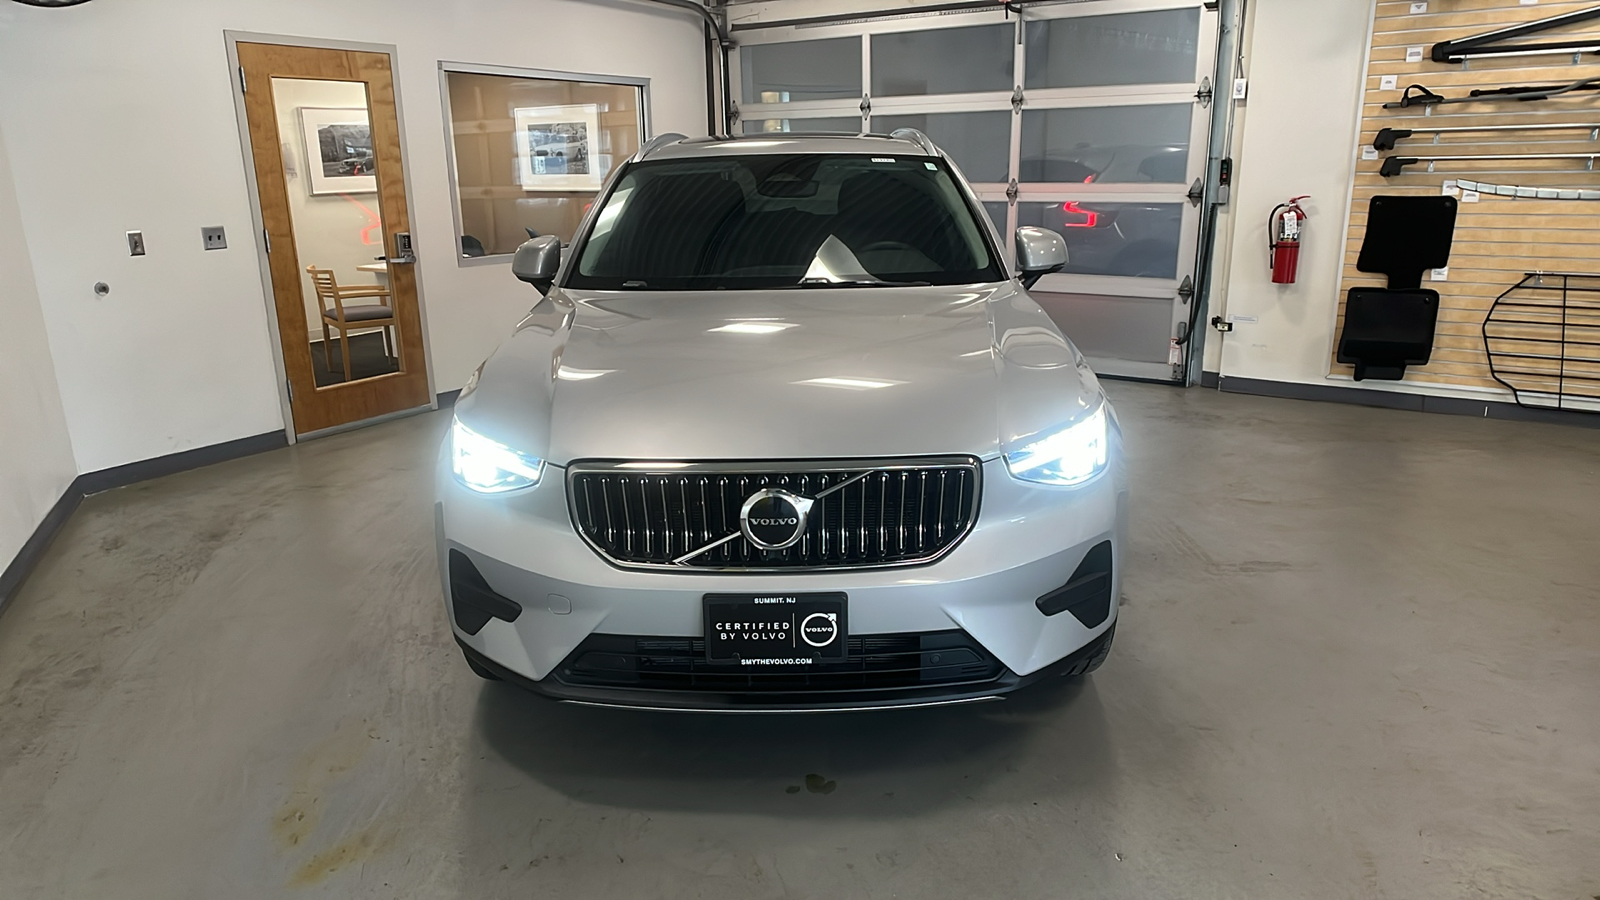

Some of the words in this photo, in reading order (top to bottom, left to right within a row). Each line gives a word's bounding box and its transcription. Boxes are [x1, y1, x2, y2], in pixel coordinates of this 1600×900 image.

[749, 517, 797, 526] VOLVO
[715, 622, 790, 630] CERTIFIED
[720, 632, 736, 640] BY
[742, 632, 786, 640] VOLVO
